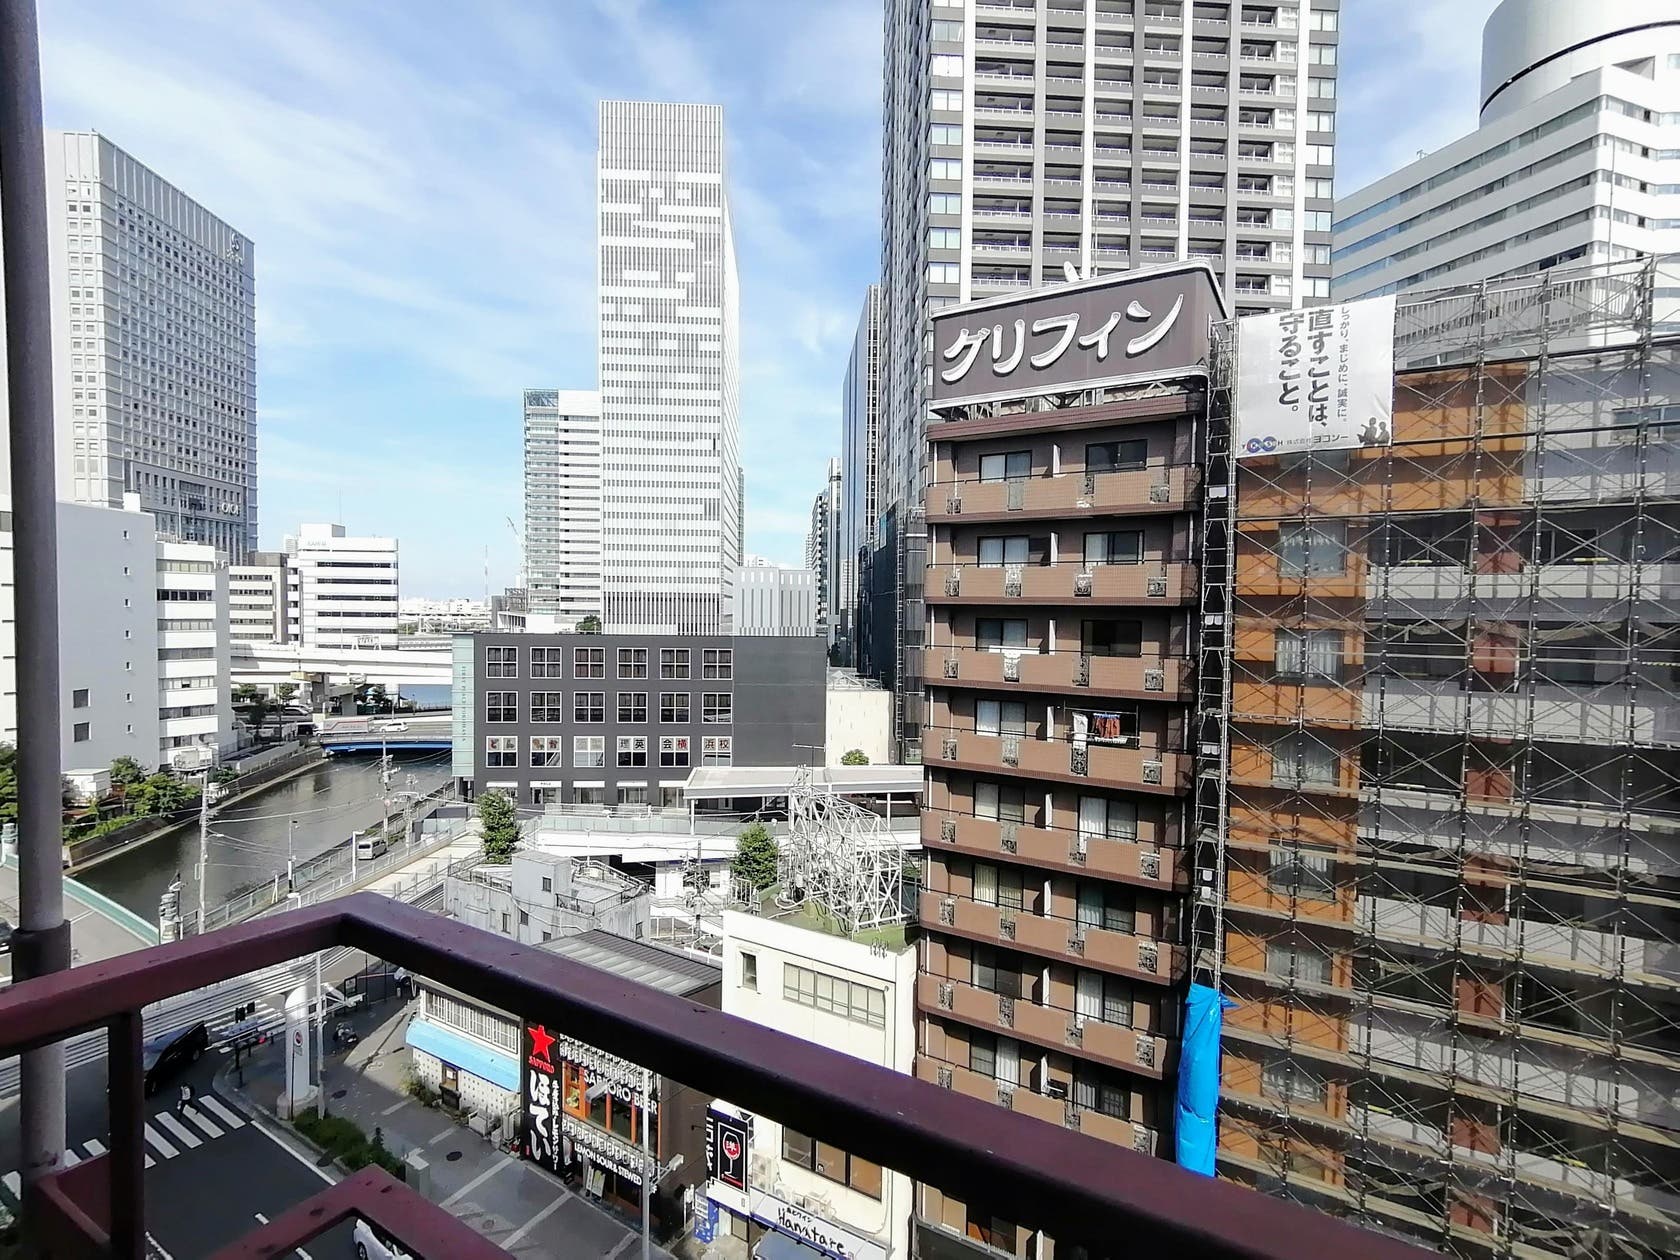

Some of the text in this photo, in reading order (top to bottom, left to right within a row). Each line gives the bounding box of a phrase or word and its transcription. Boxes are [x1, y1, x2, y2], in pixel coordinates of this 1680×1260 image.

[941, 293, 1184, 383] グリフィン
[1278, 313, 1305, 412] 守ること。
[1307, 309, 1335, 427] 直すことは、
[529, 1069, 552, 1161] ほてい
[583, 1069, 632, 1102] SAPORO
[574, 1142, 596, 1161] LEMON
[617, 1165, 642, 1186] STEWED
